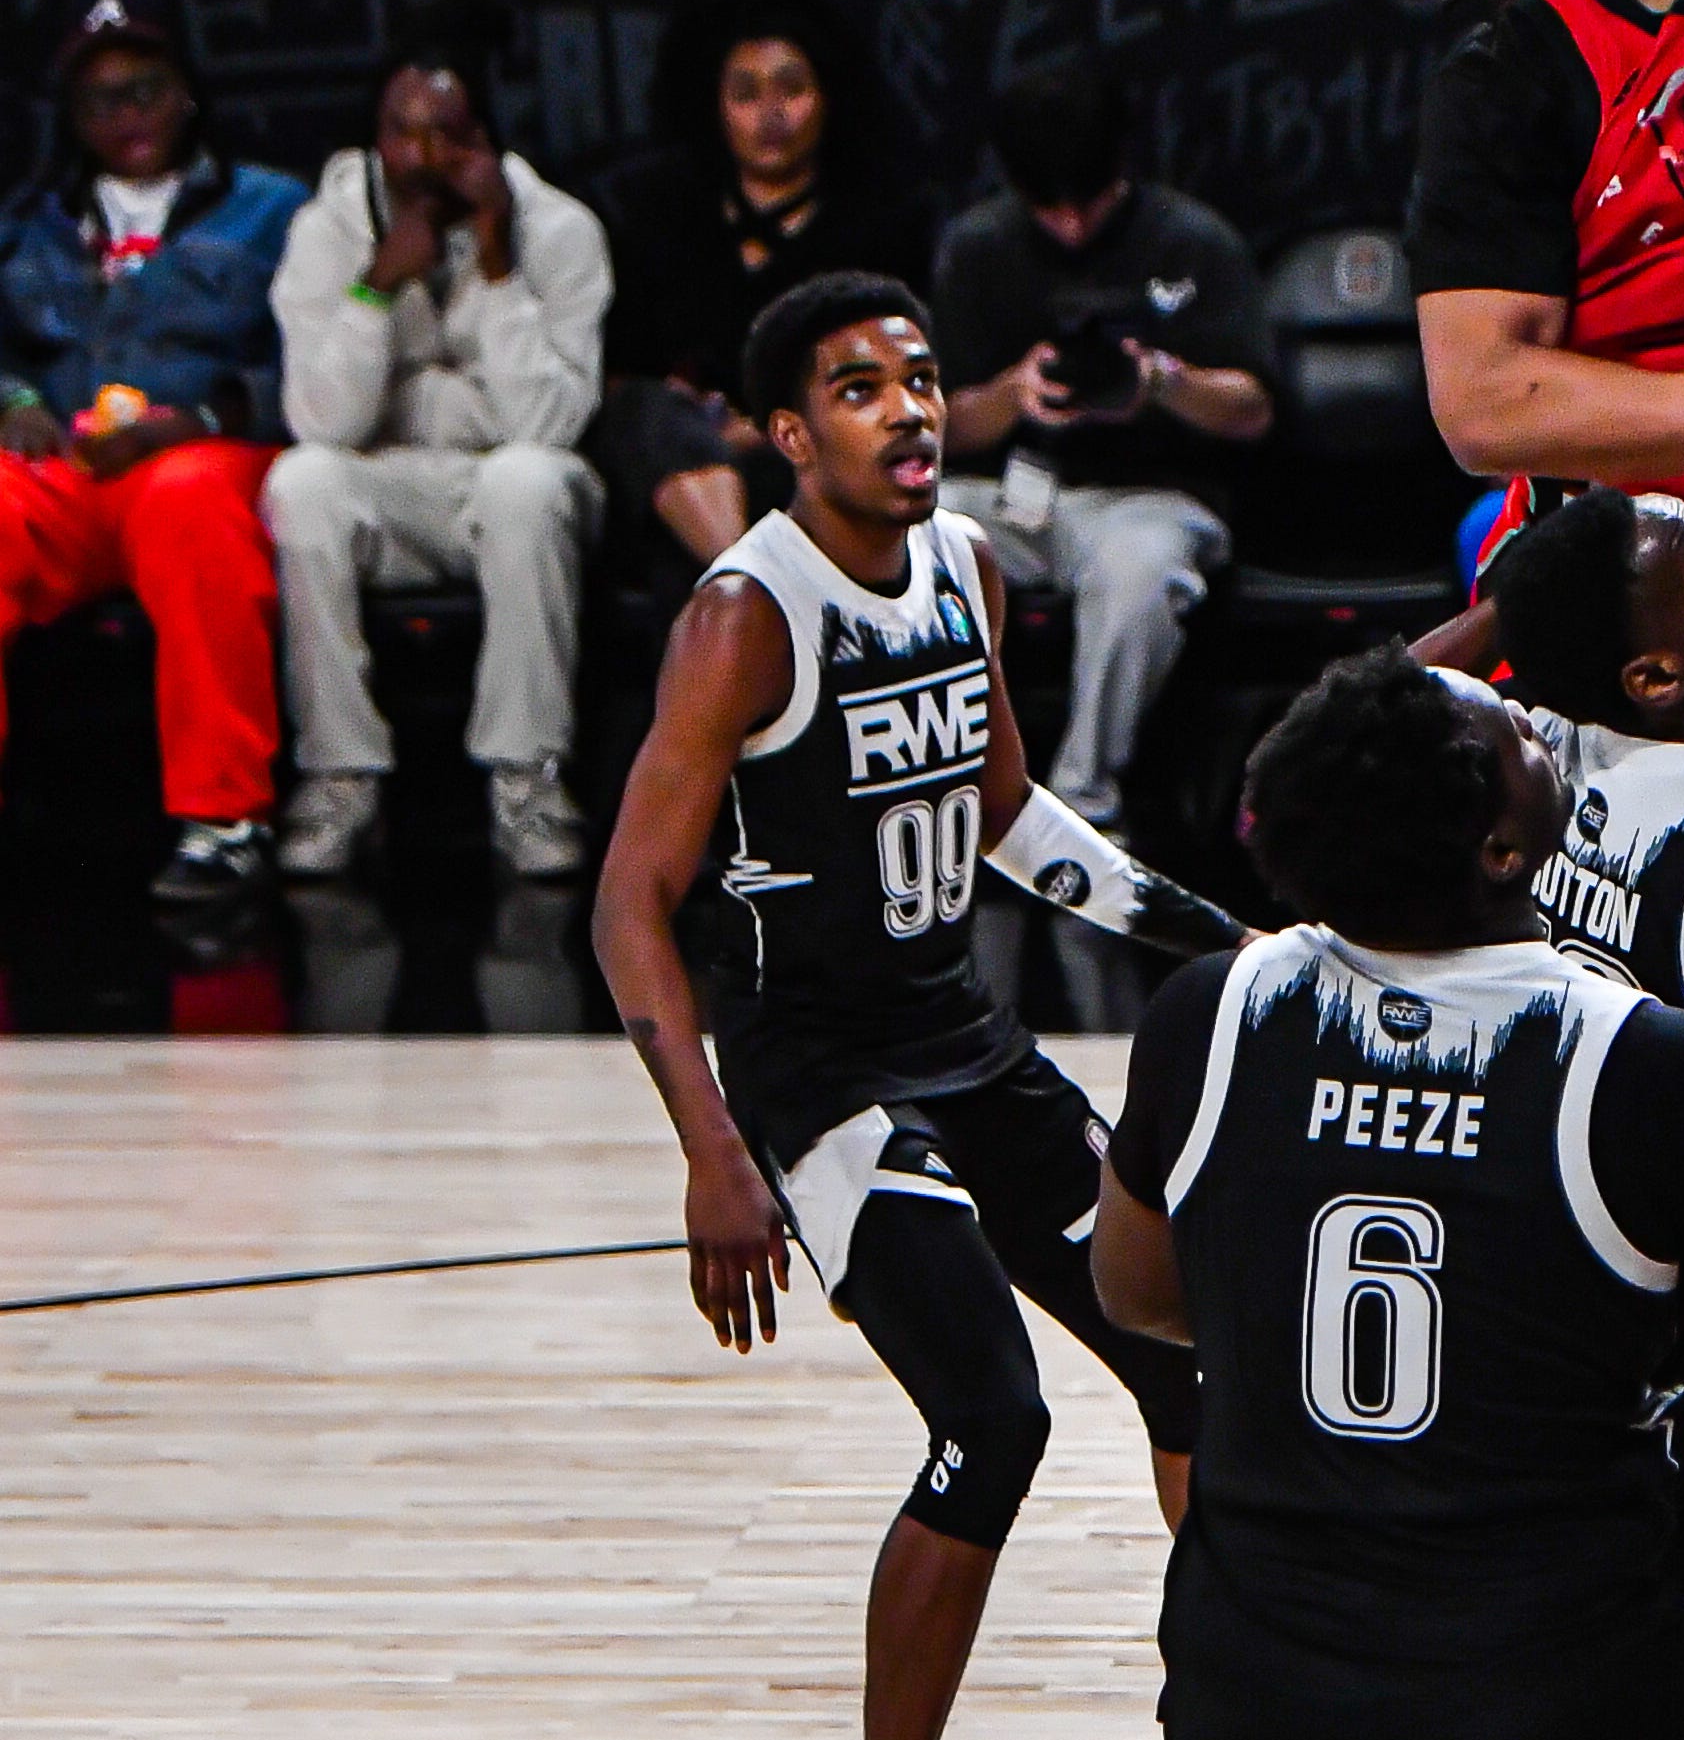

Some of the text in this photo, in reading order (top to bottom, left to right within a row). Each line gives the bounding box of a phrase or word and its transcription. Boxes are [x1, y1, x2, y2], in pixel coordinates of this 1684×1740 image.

[844, 672, 991, 781] RWE
[877, 785, 982, 940] 99
[1382, 1003, 1430, 1023] RWE
[1307, 1078, 1486, 1157] PEEZE
[1301, 1193, 1445, 1441] 6
